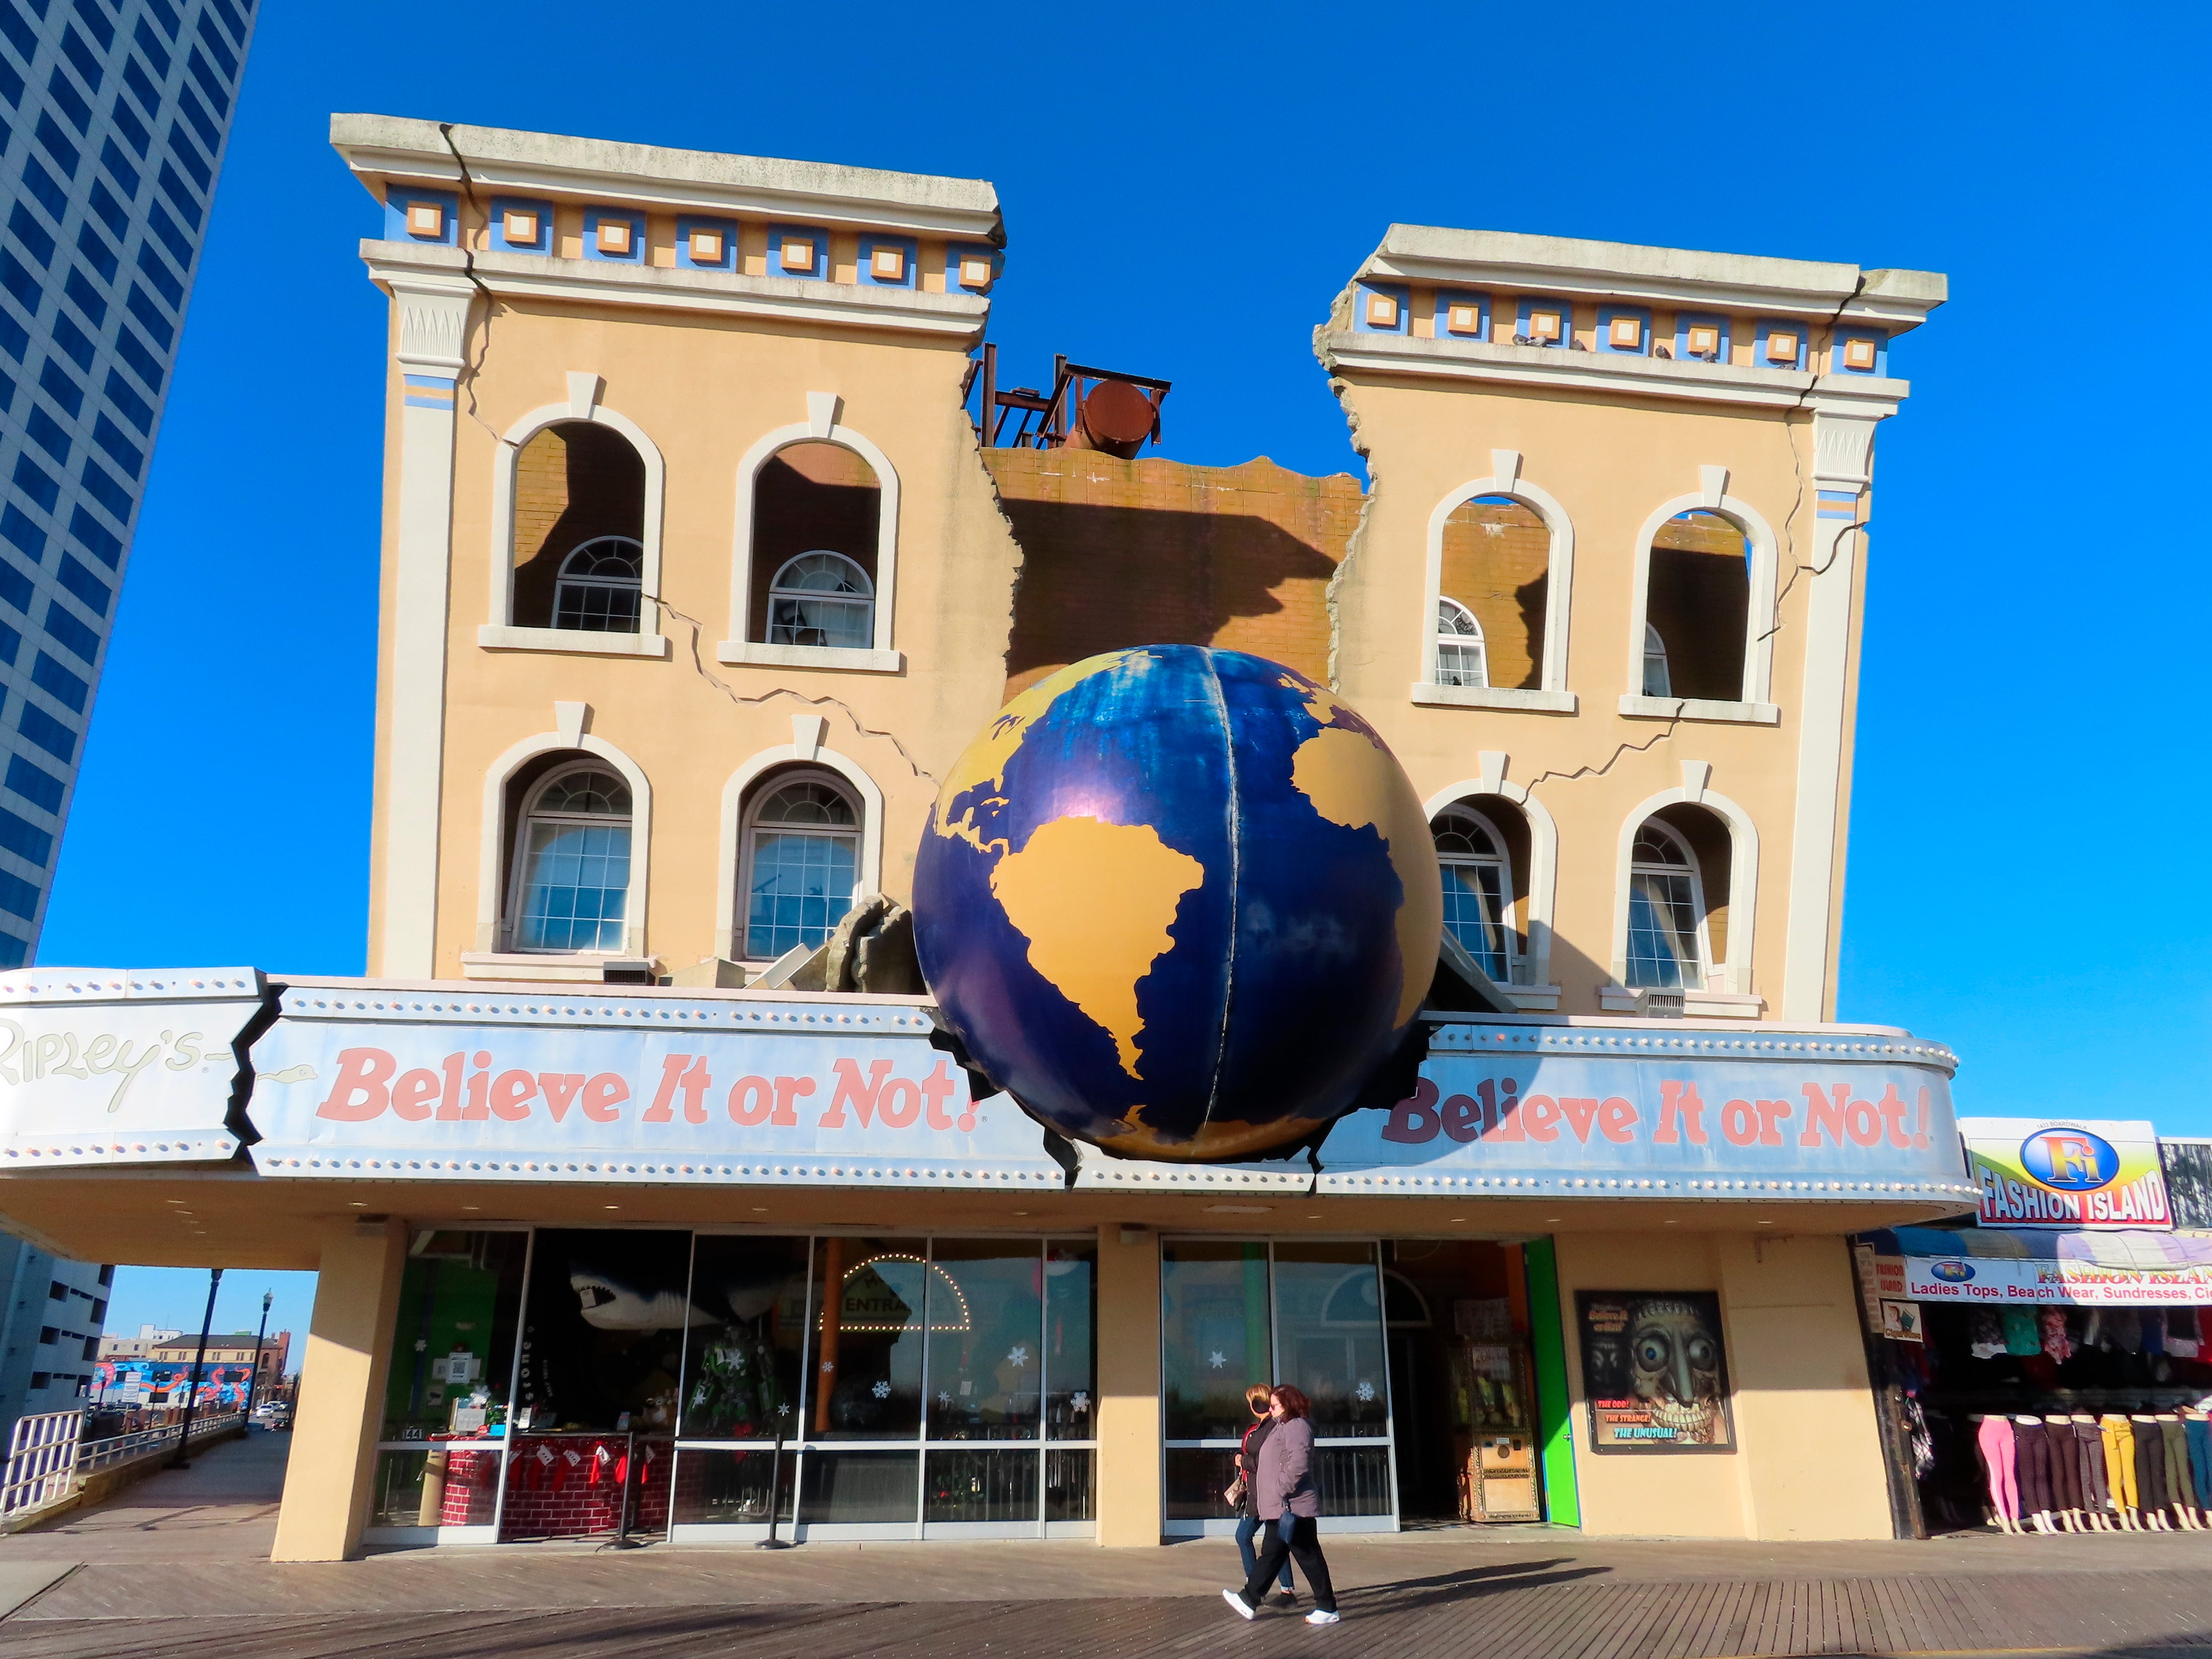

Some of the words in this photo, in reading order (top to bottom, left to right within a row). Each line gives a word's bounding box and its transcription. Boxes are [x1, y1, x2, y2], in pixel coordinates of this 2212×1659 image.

[316, 1047, 630, 1123] Believe
[642, 1054, 712, 1124] It
[728, 1075, 817, 1126] or
[1381, 1077, 1639, 1144] Believe
[1653, 1080, 1708, 1145] It
[1721, 1100, 1792, 1146] or
[1800, 1083, 1930, 1150] Not!
[2049, 1121, 2088, 1130] BOARDWALK
[1978, 1163, 2081, 1220] FASHION
[2086, 1170, 2165, 1221] ISLAND
[2037, 1263, 2145, 1284] FASHION
[1911, 1282, 1959, 1295] Ladies
[1963, 1284, 2003, 1298] Tops,
[2007, 1285, 2054, 1298] Beach
[2058, 1286, 2098, 1299] Wear,
[2104, 1286, 2192, 1300] Sundresses,
[1612, 1400, 1630, 1408] ODD!
[1606, 1414, 1619, 1422] THE
[1620, 1414, 1651, 1423] STRANGE!
[1614, 1427, 1633, 1438] THE
[1633, 1428, 1678, 1438] UNUSUAL!
